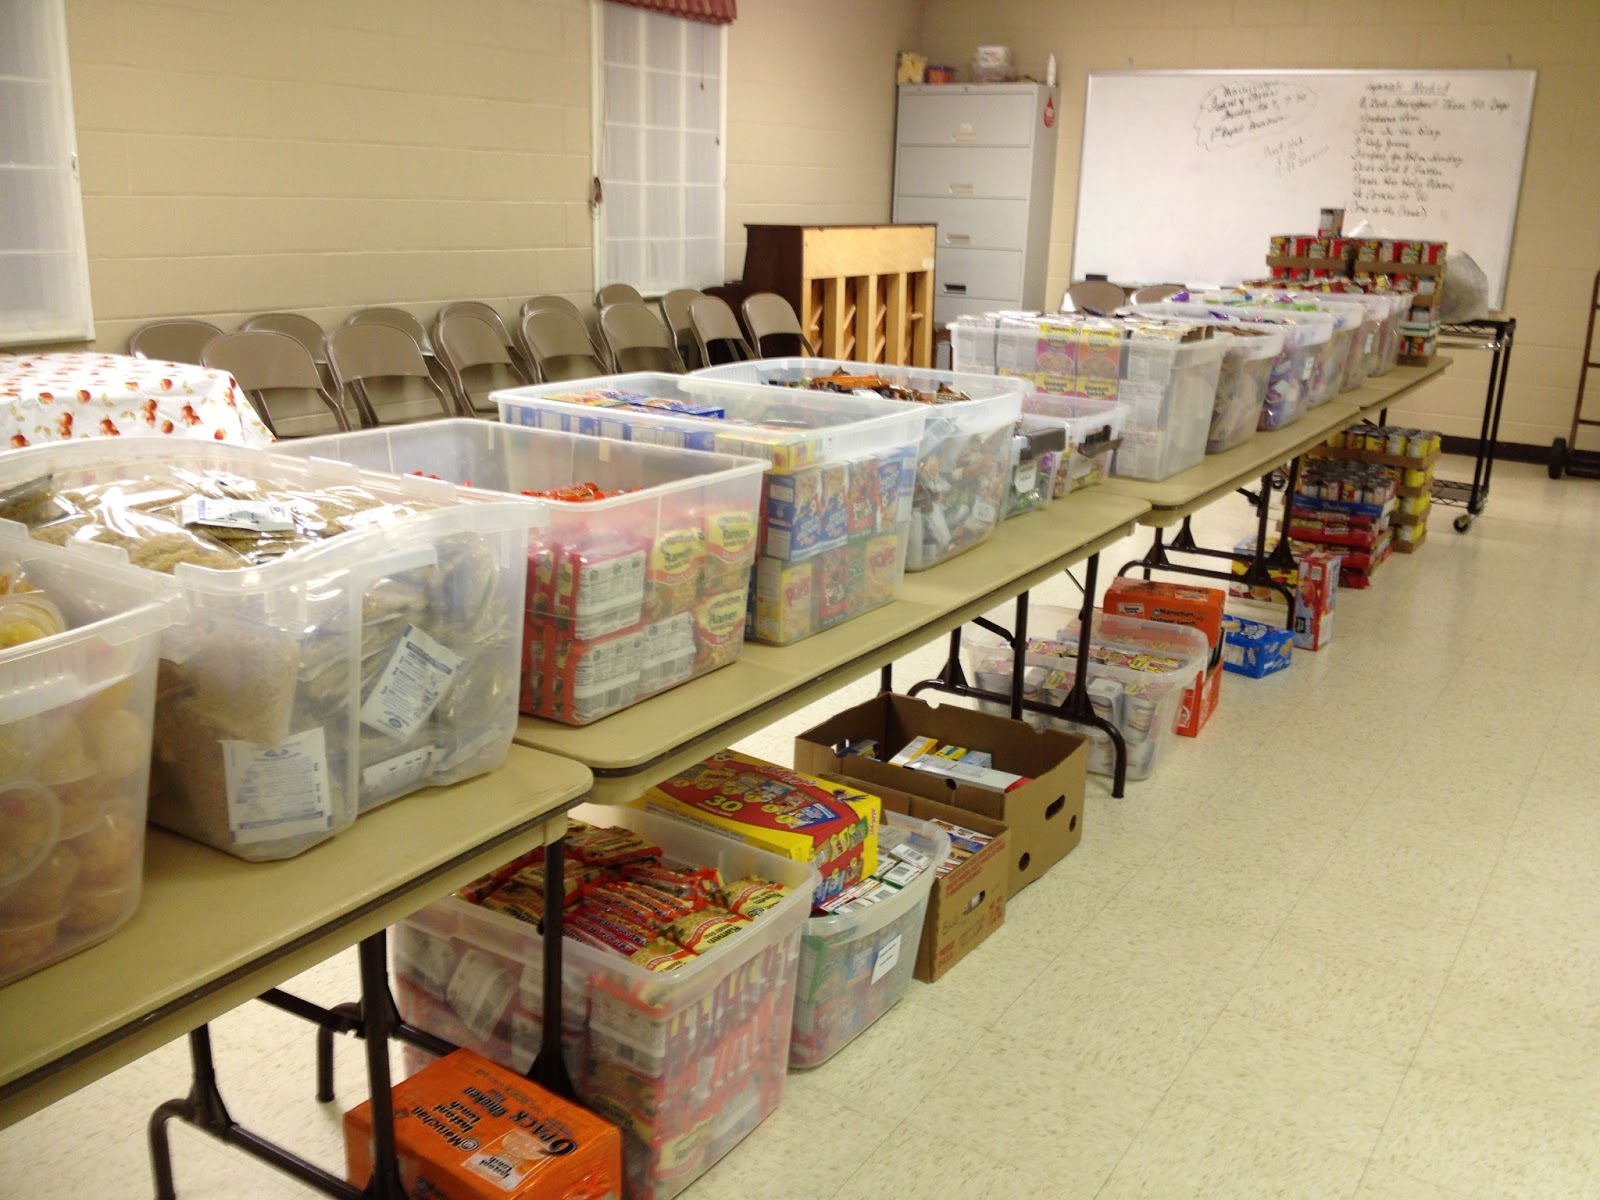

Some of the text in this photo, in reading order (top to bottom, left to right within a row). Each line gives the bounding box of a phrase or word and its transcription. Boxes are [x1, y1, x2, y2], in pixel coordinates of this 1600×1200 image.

[704, 795, 744, 812] 30
[706, 925, 743, 945] Ramen
[450, 1100, 483, 1125] Lunch
[410, 1105, 463, 1148] Maruchan
[510, 1109, 556, 1143] PACK
